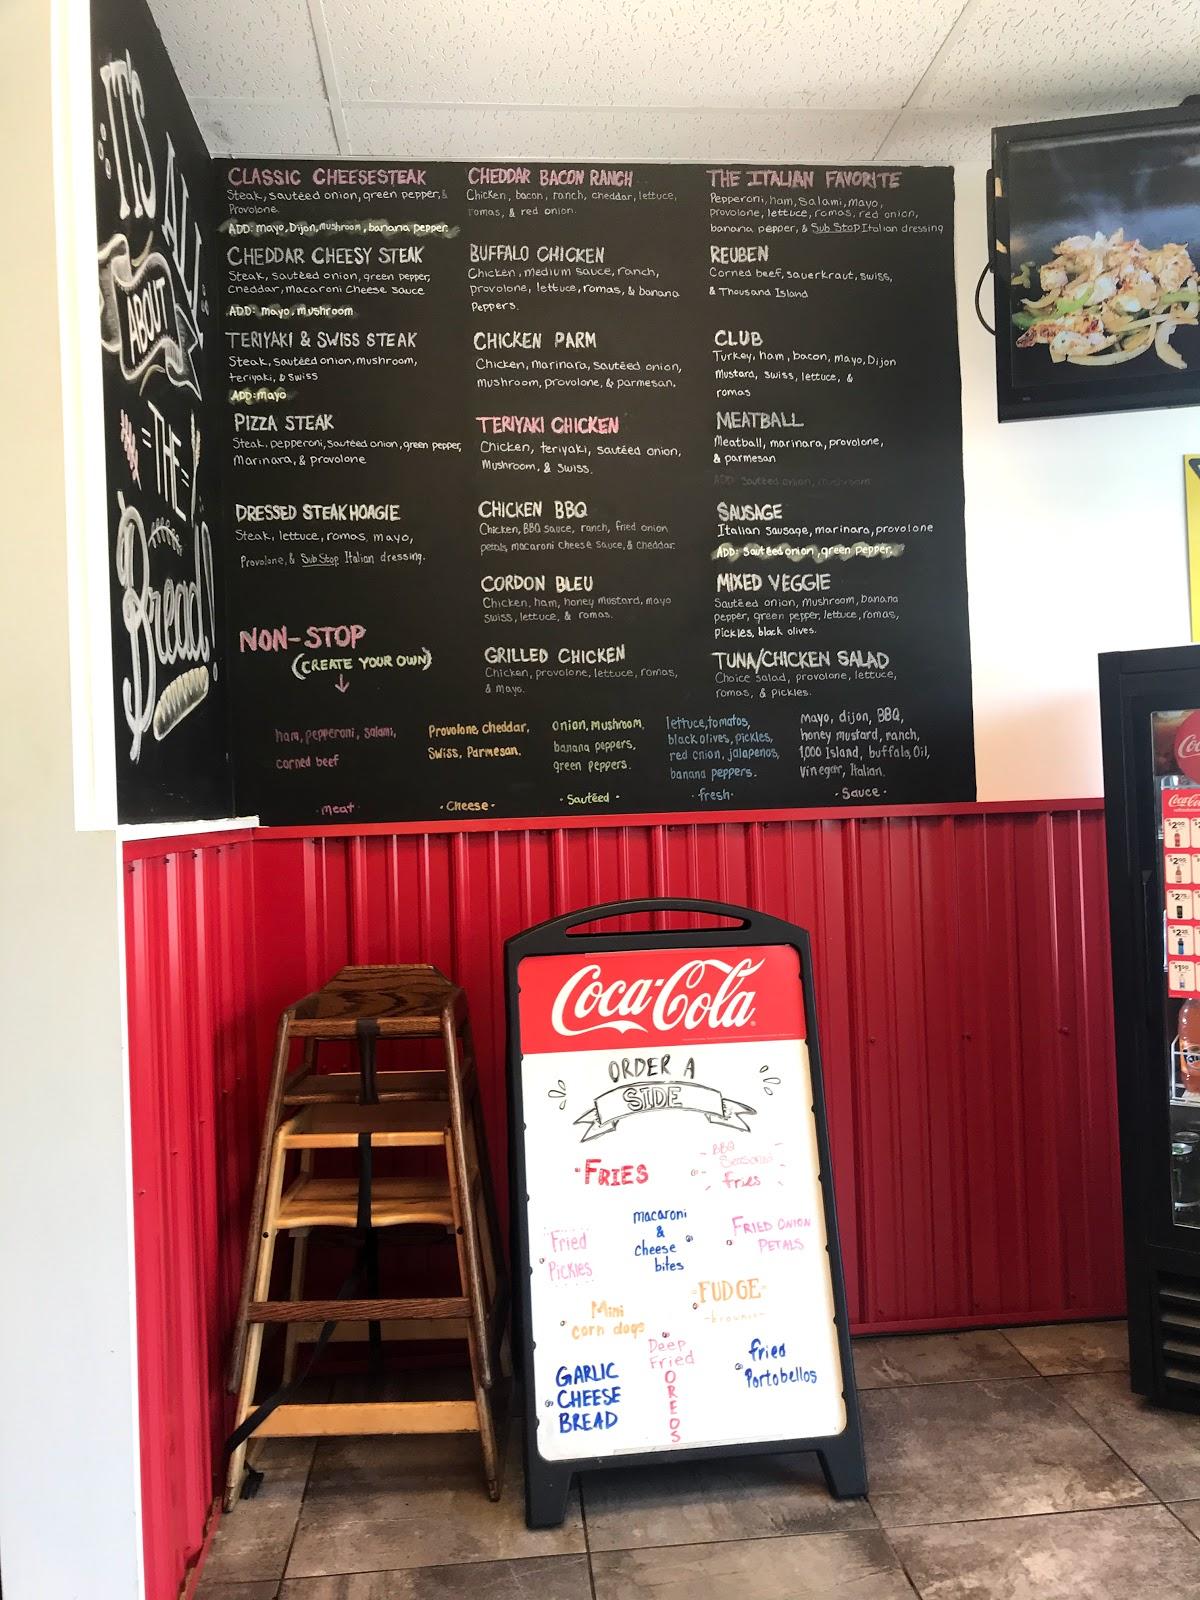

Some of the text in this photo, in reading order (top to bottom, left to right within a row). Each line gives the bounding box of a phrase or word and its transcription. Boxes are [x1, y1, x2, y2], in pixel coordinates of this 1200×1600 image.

[228, 168, 427, 186] CLASSIC CHEESESTEAK
[468, 167, 634, 187] CHEDDAR BACON RANCH
[706, 170, 902, 189] THE ITALIAN FAVORITE
[227, 246, 424, 266] CHEDDAR CHEESY STEAK
[470, 244, 605, 263] BUFFALO CHICKEN
[711, 245, 769, 265] REUBEN
[618, 267, 659, 278] ranch,
[756, 268, 784, 279] beef,
[787, 271, 858, 280] sauerkraut,
[709, 287, 808, 298] & Thousand Island
[127, 278, 169, 364] ABOUT
[225, 331, 418, 349] TERIYAKI & SWISS STEAK
[474, 331, 596, 350] CHICKEN PARM
[715, 330, 763, 347] CLUB
[234, 413, 335, 432] PIZZA STEAK
[476, 416, 619, 434] TERIYAKI CHICKEN
[716, 411, 804, 430] MEATBALL
[148, 400, 187, 522] THE
[299, 455, 306, 466] &
[310, 455, 367, 467] provolone
[544, 463, 551, 473] &
[713, 453, 776, 465] & parmesan
[236, 504, 401, 522] DRESSED STEAK HOAGIE
[478, 500, 588, 519] CHICKEN BBQ
[717, 502, 783, 522] SAUSAGE
[717, 524, 761, 537] Italian
[876, 523, 934, 535] provolone
[481, 575, 593, 593] CORDON BLEU
[717, 573, 831, 592] MIXED VEGGIE
[239, 625, 366, 652] NON-STOP
[758, 627, 783, 636] black
[788, 627, 817, 636] olives.
[485, 644, 626, 664] GRILLED CHICKEN
[711, 648, 890, 674] TUNA/CHICKEN SALAD
[292, 647, 432, 680] (CREATE YOUR OWN)
[839, 710, 872, 725] dijon,
[877, 707, 904, 724] BBQ,
[668, 733, 698, 745] black
[700, 734, 733, 746] olives,
[801, 729, 832, 744] honey
[886, 729, 920, 742] ranch,
[554, 741, 590, 753] banana
[670, 750, 688, 761] red
[826, 746, 862, 760] Island,
[276, 755, 339, 770] corned beef
[553, 761, 581, 772] green
[671, 768, 706, 780] banana
[551, 957, 766, 1036] Coca-Cola
[608, 1054, 695, 1082] ORDER A
[622, 1086, 682, 1111] SIDE
[584, 1158, 649, 1186] FRIES
[633, 1208, 687, 1224] macaroni
[732, 1216, 812, 1234] FRIED ONION
[656, 1226, 665, 1238] &
[550, 1230, 587, 1253] Fried
[634, 1240, 677, 1256] cheese
[758, 1239, 804, 1253] PETALS
[654, 1257, 684, 1272] bites
[698, 1278, 762, 1303] FUDGE
[591, 1301, 624, 1319] Mini
[572, 1322, 645, 1339] corn dogs
[649, 1338, 687, 1353] Deep
[749, 1338, 786, 1361] fried
[649, 1351, 694, 1369] Fried
[556, 1363, 619, 1387] GARLIC
[557, 1387, 621, 1409] CHEESE
[559, 1411, 618, 1433] BREAD
